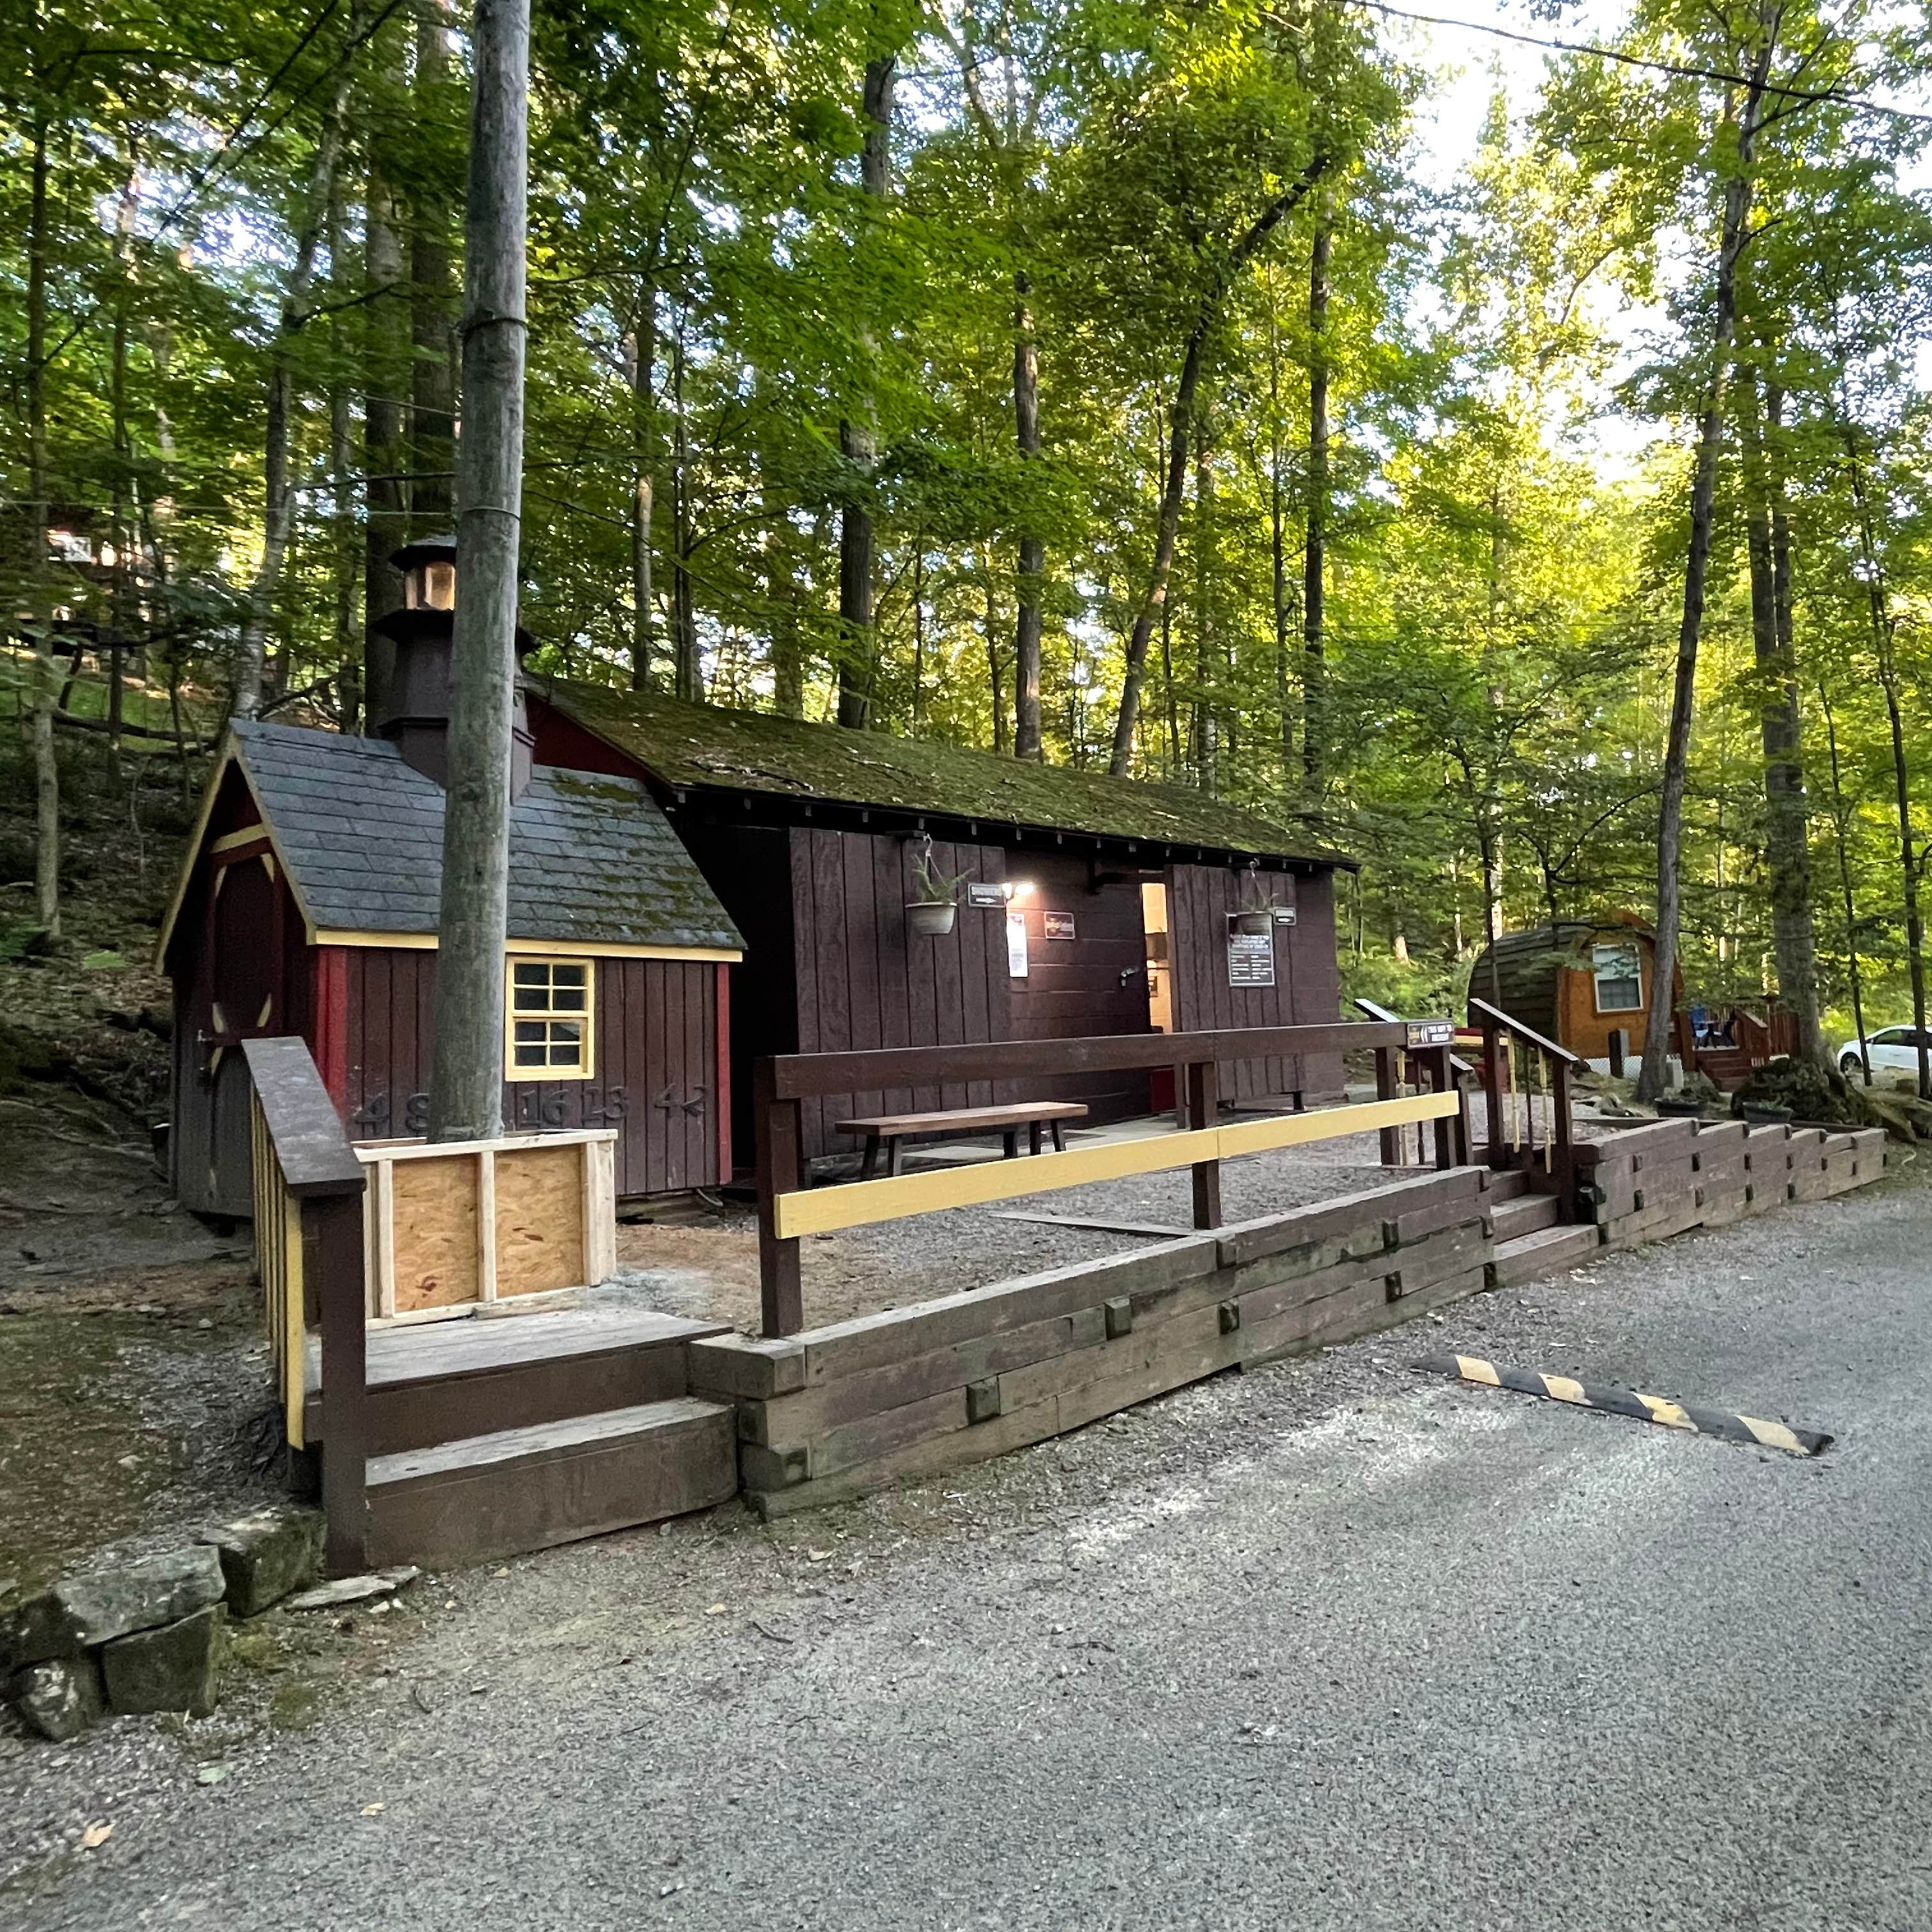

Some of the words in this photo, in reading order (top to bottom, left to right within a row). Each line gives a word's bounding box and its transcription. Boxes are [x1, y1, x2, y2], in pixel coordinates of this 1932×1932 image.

[353, 1090, 390, 1135] 4
[520, 1089, 568, 1125] 16
[653, 1083, 709, 1118] 42
